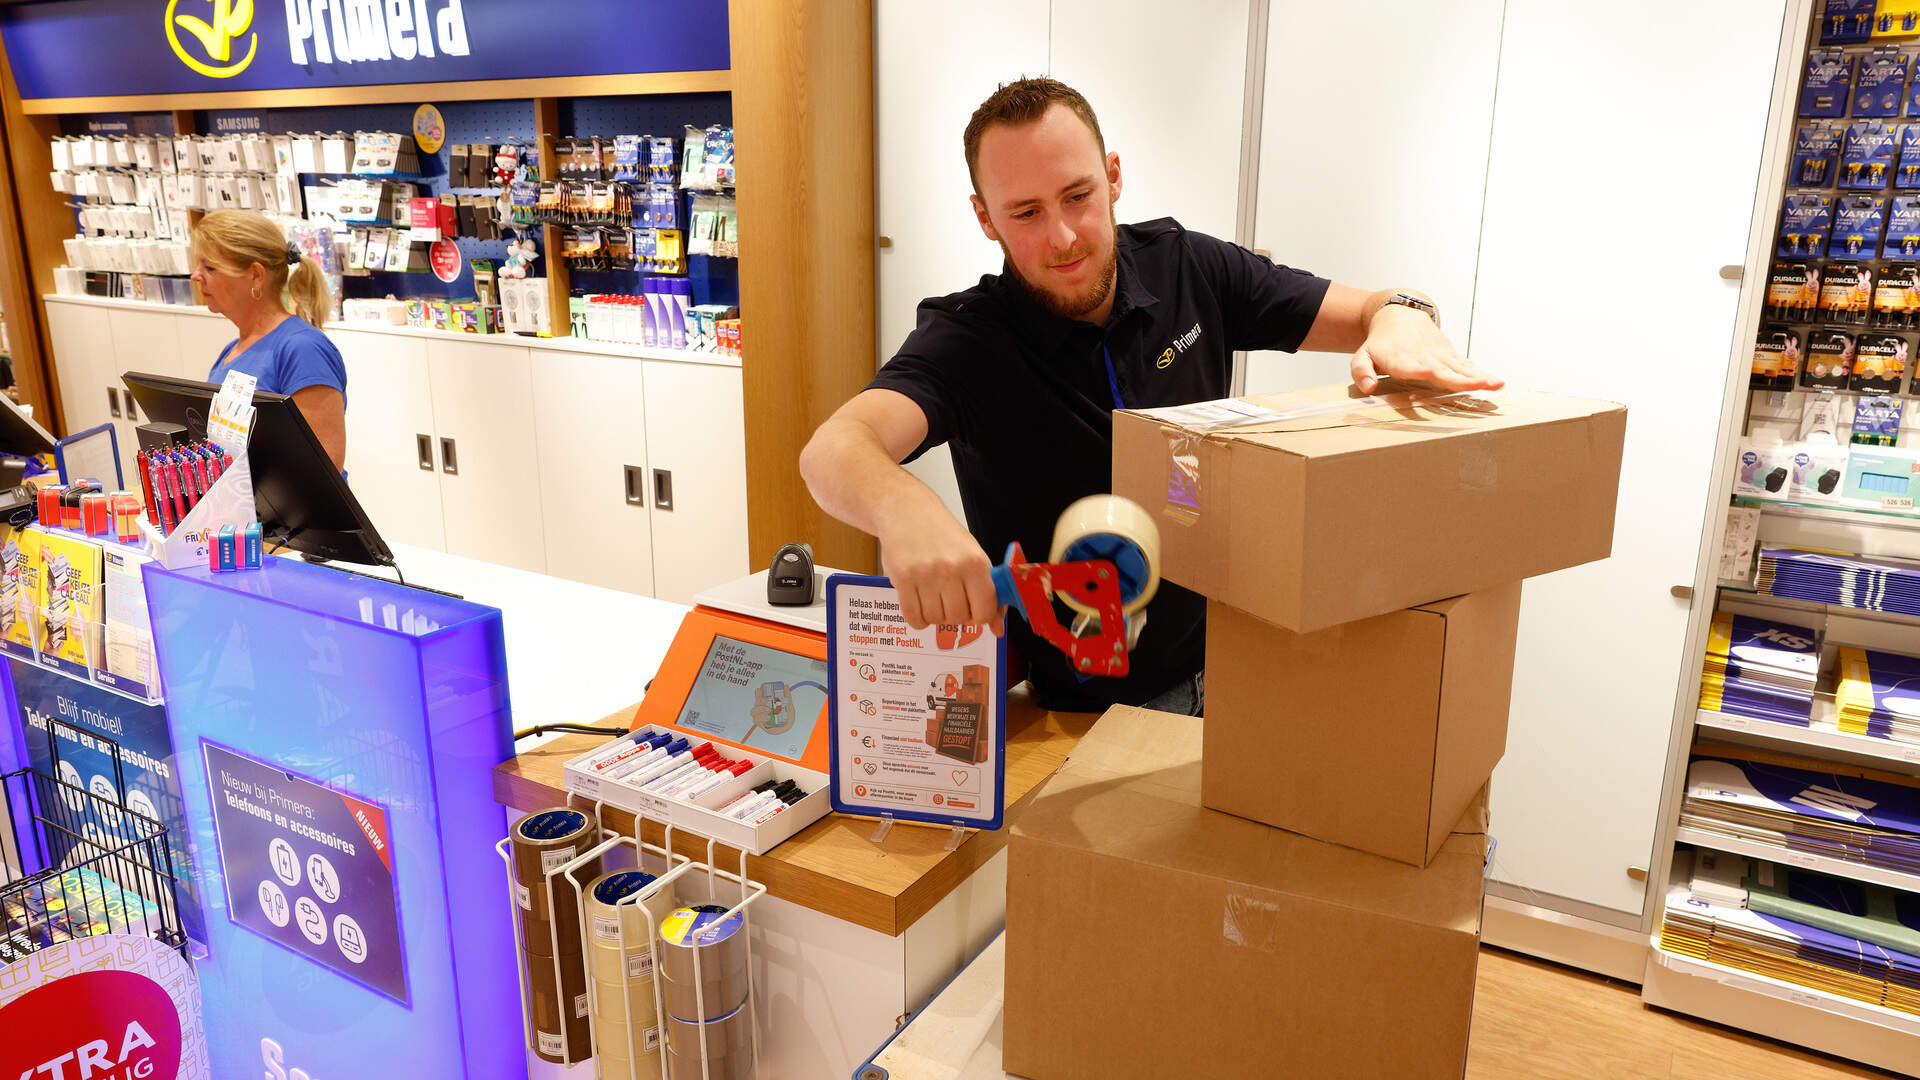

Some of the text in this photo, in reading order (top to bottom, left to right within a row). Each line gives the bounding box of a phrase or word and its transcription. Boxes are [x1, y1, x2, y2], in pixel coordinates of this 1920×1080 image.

[284, 0, 470, 65] Primera
[216, 118, 260, 130] SAMSUNG
[1850, 137, 1893, 145] VARTA
[1788, 208, 1828, 216] VARTA
[1840, 210, 1881, 218] VARTA
[1173, 322, 1202, 352] Primera
[1858, 408, 1899, 418] VARTA
[16, 553, 29, 564] GEEF
[66, 567, 81, 579] GEEF
[849, 598, 899, 611] Helaas hebben
[849, 610, 859, 619] het
[861, 612, 882, 621] besluit
[849, 622, 907, 635] dat wij per direct
[849, 634, 924, 648] stoppen met PostNL.
[1753, 628, 1815, 649] XS
[718, 642, 746, 656] Met de
[42, 654, 59, 668] Service
[714, 652, 763, 670] PostNL-app
[710, 660, 755, 678] heb je alles
[97, 671, 116, 685] Service
[716, 672, 726, 681] de
[727, 673, 749, 686] hand
[56, 696, 124, 736] Blijf mobiel!
[80, 733, 96, 750] en
[943, 735, 971, 745] GESTOPT
[221, 770, 316, 820] Nieuw bij Primera:
[224, 790, 355, 857] Telefoons en accessoires
[355, 810, 384, 850] NIEUW
